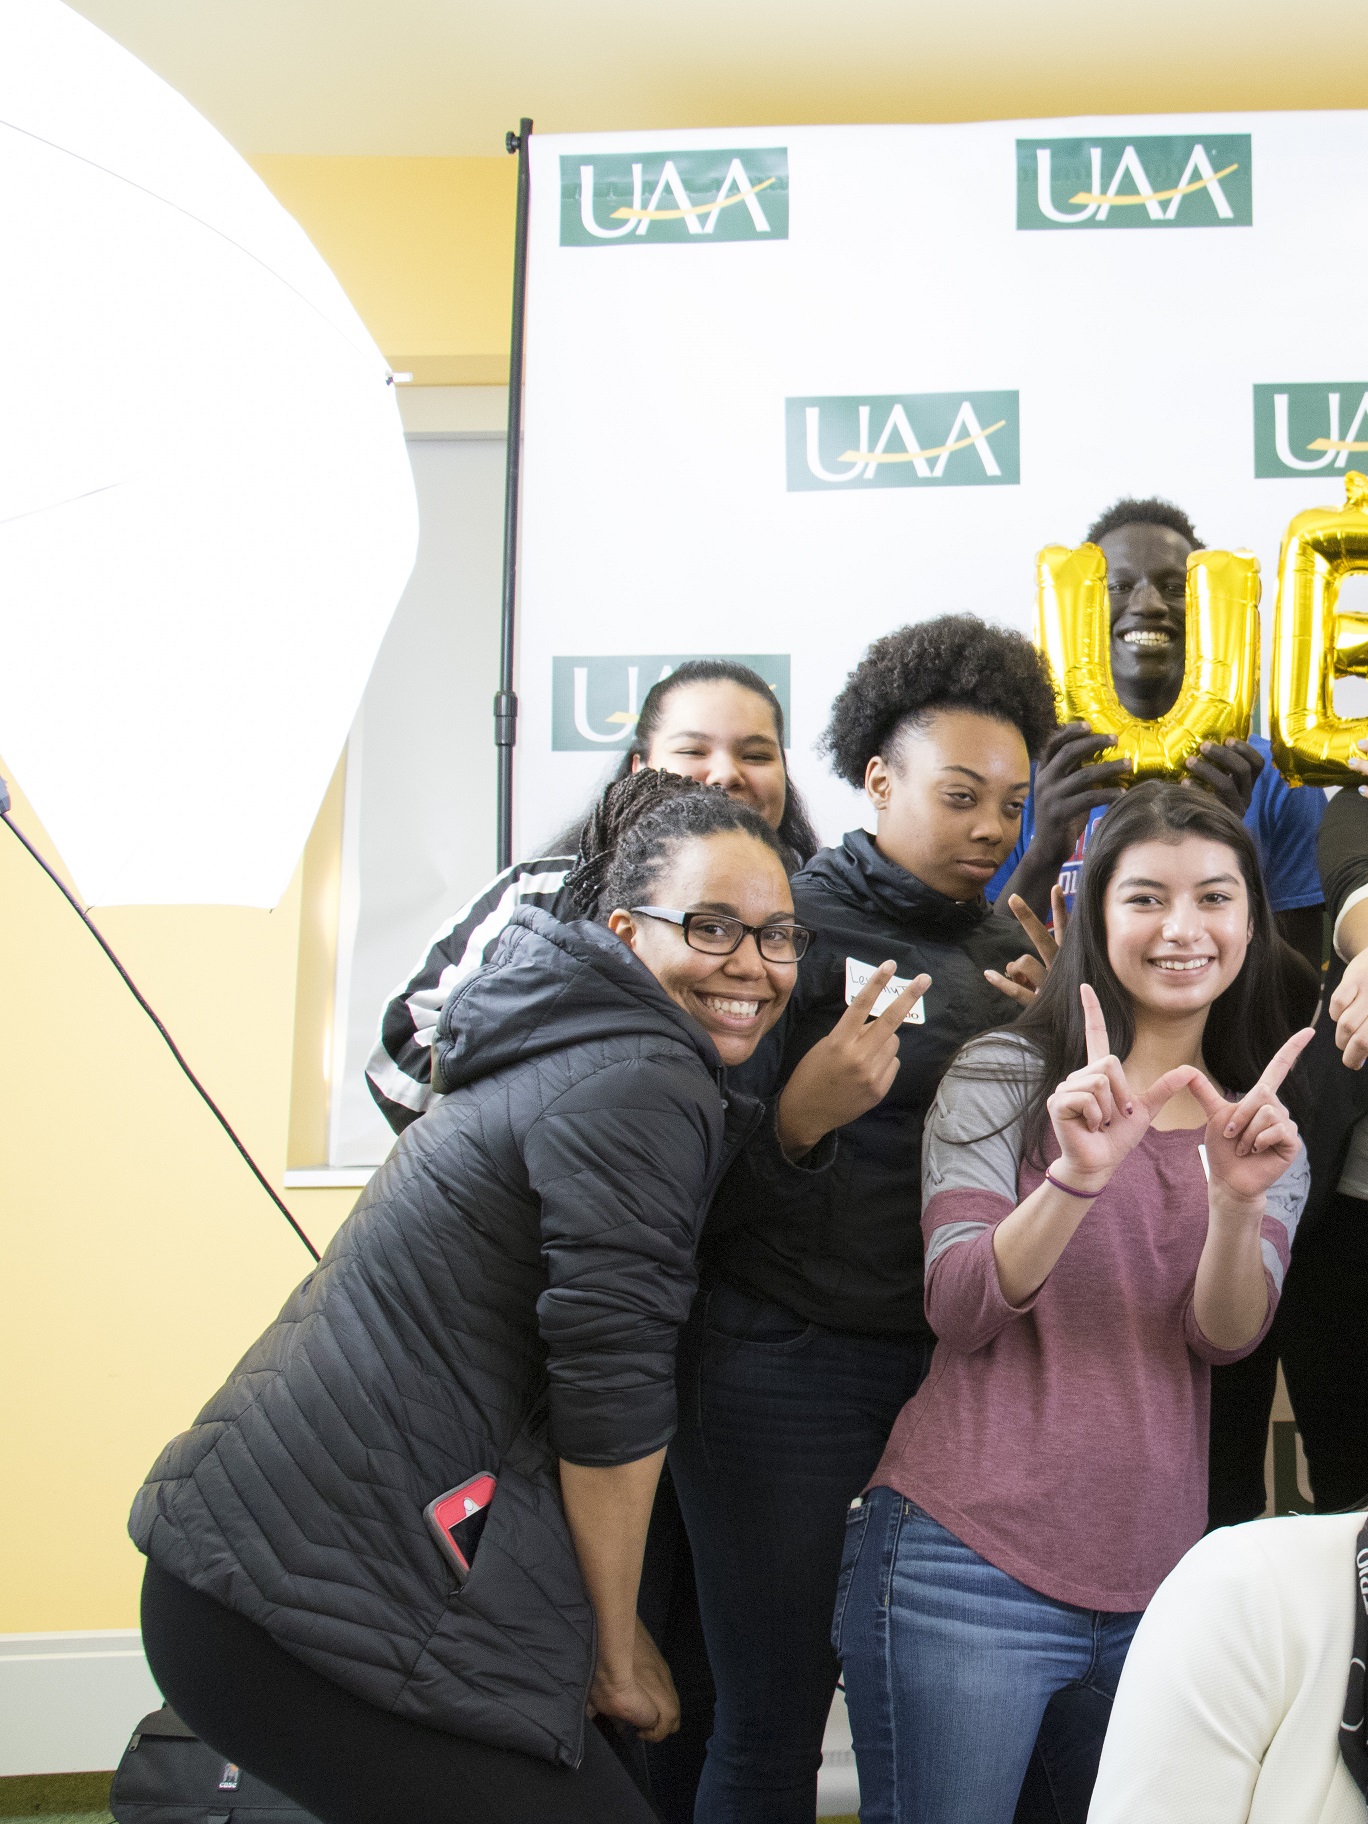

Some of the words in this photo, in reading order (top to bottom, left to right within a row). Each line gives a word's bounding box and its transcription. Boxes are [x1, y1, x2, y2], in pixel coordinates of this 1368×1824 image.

[580, 158, 773, 238] UAA
[1036, 144, 1236, 223] UAA
[805, 401, 1004, 482] UAA
